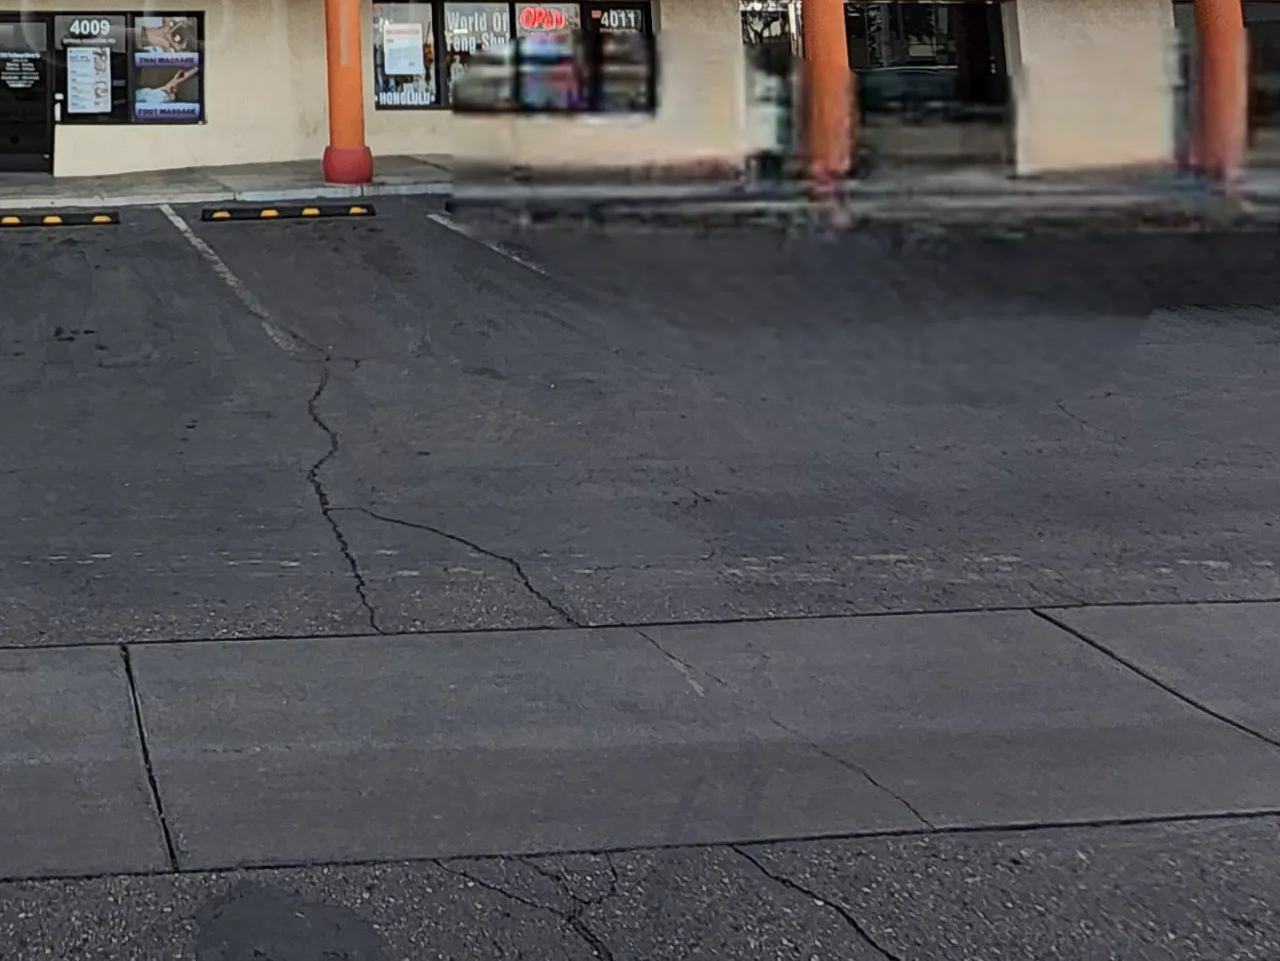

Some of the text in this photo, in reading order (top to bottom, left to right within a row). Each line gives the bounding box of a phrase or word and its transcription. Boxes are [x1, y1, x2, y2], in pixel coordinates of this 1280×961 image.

[445, 11, 487, 32] World
[519, 5, 566, 30] OPEN
[601, 9, 636, 27] 4011
[69, 19, 111, 36] 4009
